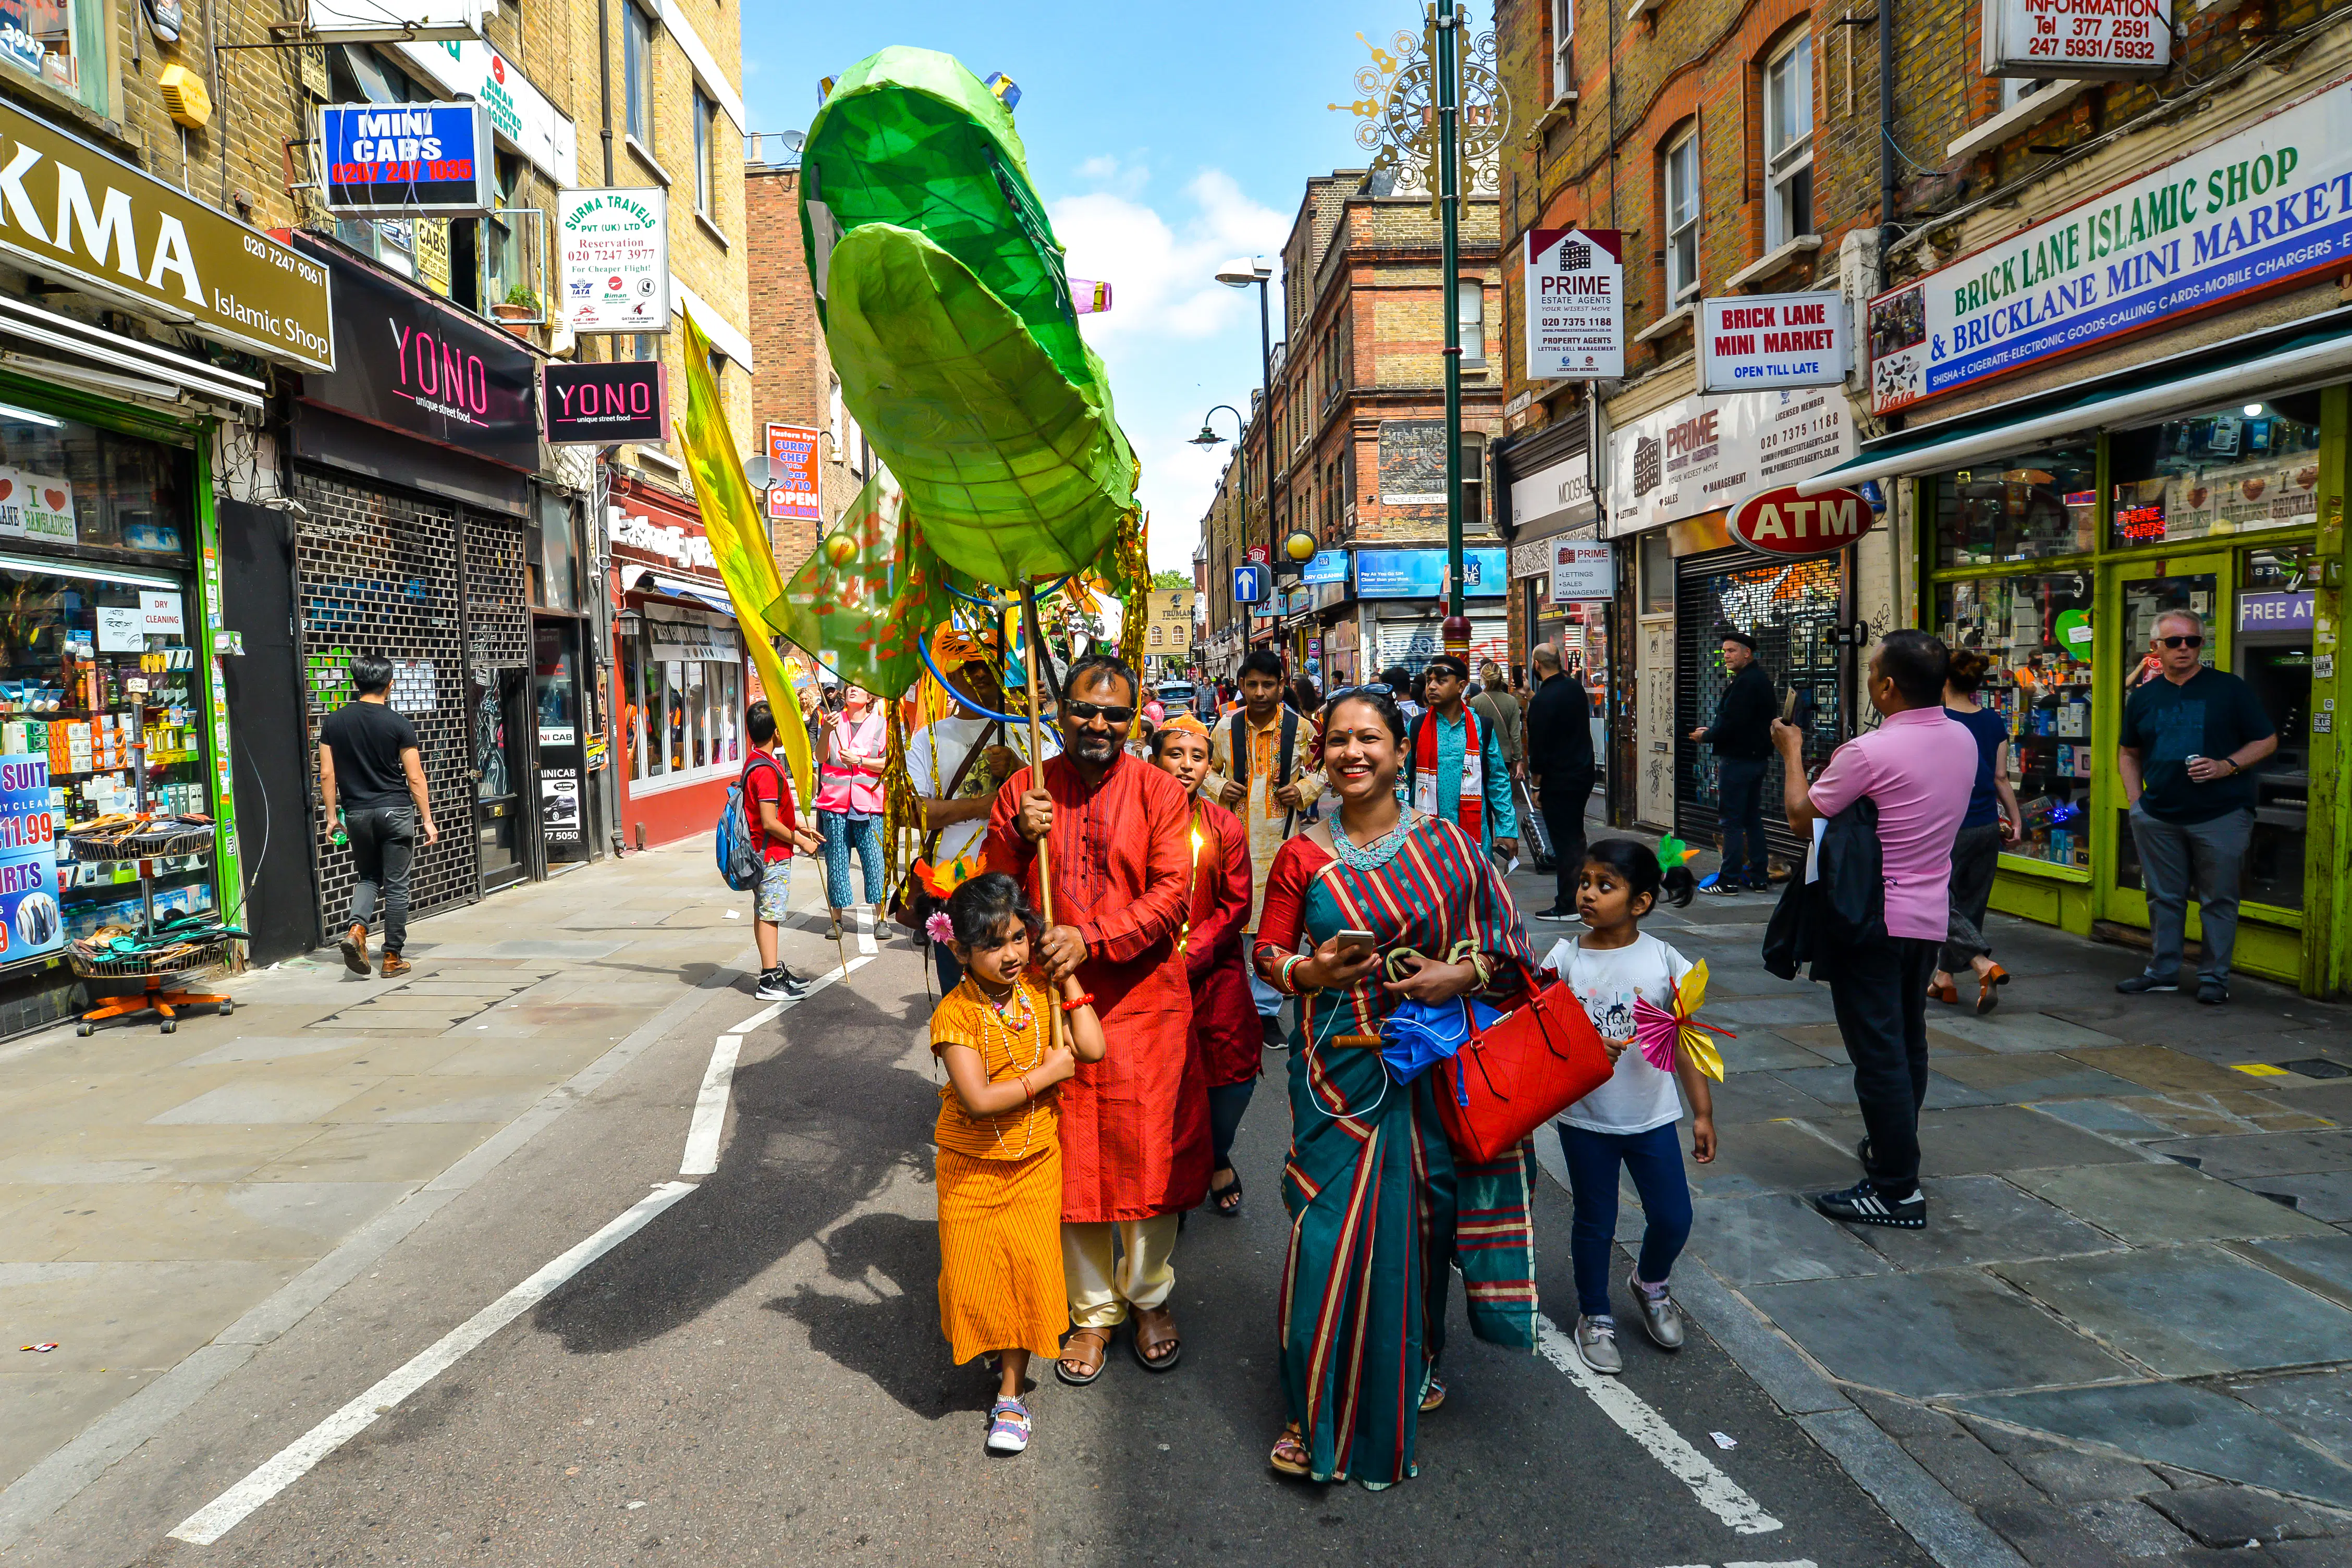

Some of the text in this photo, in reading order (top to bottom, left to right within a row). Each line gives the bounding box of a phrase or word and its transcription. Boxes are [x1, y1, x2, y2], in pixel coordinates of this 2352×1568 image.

[157, 4, 177, 22] ACTIVE
[2026, 0, 2159, 18] INFORMATION
[2035, 15, 2149, 38] Tel 377 2591
[2029, 38, 2154, 59] 247 5931/5932
[46, 56, 67, 74] LINES
[486, 75, 513, 109] BIMAN
[480, 85, 522, 131] APPROVED
[358, 112, 433, 138] MINI
[487, 105, 518, 141] AGENTS
[352, 137, 442, 162] CABS
[332, 159, 472, 183] 0207 247 1035
[566, 196, 656, 230] SURMA TRAVELS
[420, 223, 446, 256] CABS
[1955, 147, 2298, 316] BRICK LANE ISLAMIC SHOP
[580, 238, 644, 248] Reservation
[243, 235, 323, 287] 020 7247 9061
[434, 253, 447, 266] WANTED
[568, 249, 655, 261] 020 7247 3977
[588, 265, 621, 274] Cheaper
[624, 264, 651, 273] Flight!
[1931, 172, 2352, 361] & BRICKLANE MINI MARKET
[1541, 276, 1611, 295] PRIME
[214, 287, 328, 359] Islamic Shop
[1542, 317, 1611, 326] 020 7375 1188
[1722, 304, 1825, 330] BRICK LANE
[1933, 367, 1966, 386] SHISHA-E
[2255, 240, 2331, 276] CHARGERS
[1715, 329, 1834, 357] MINI MARKET
[389, 317, 487, 414] YONO
[1734, 362, 1819, 378] OPEN TILL LATE
[415, 396, 470, 424] unique street food
[556, 383, 650, 415] YONO
[1775, 406, 1799, 421] LICENSED
[1801, 396, 1824, 412] MEMBER
[1878, 389, 1916, 411] Bata
[771, 430, 816, 441] Eastern Eye
[1666, 409, 1719, 458] PRIME
[1761, 412, 1838, 450] 020 7375 1188
[775, 440, 813, 452] CURRY
[779, 452, 808, 463] CHEF
[1702, 461, 1719, 473] MOVE
[779, 480, 811, 491] 9/10
[1709, 472, 1746, 492] MANAGEMENT
[27, 485, 40, 508] I
[772, 491, 817, 506] OPEN
[1664, 493, 1679, 506] SALES
[2272, 492, 2318, 519] BRICKLAN
[0, 505, 19, 526] ANE
[24, 510, 74, 537] BANGLADESH
[1620, 506, 1638, 520] LETTINGS
[1752, 498, 1858, 540] ATM
[1577, 549, 1608, 558] PRIME
[1463, 564, 1478, 573] ALK
[1255, 596, 1285, 612] PIZ!
[2243, 600, 2314, 620] FREE AT
[146, 615, 179, 623] CLEANING
[2, 761, 47, 791] SUIT
[14, 799, 50, 811] CLEAN
[0, 812, 53, 851] 11.99
[556, 831, 579, 840] 5050
